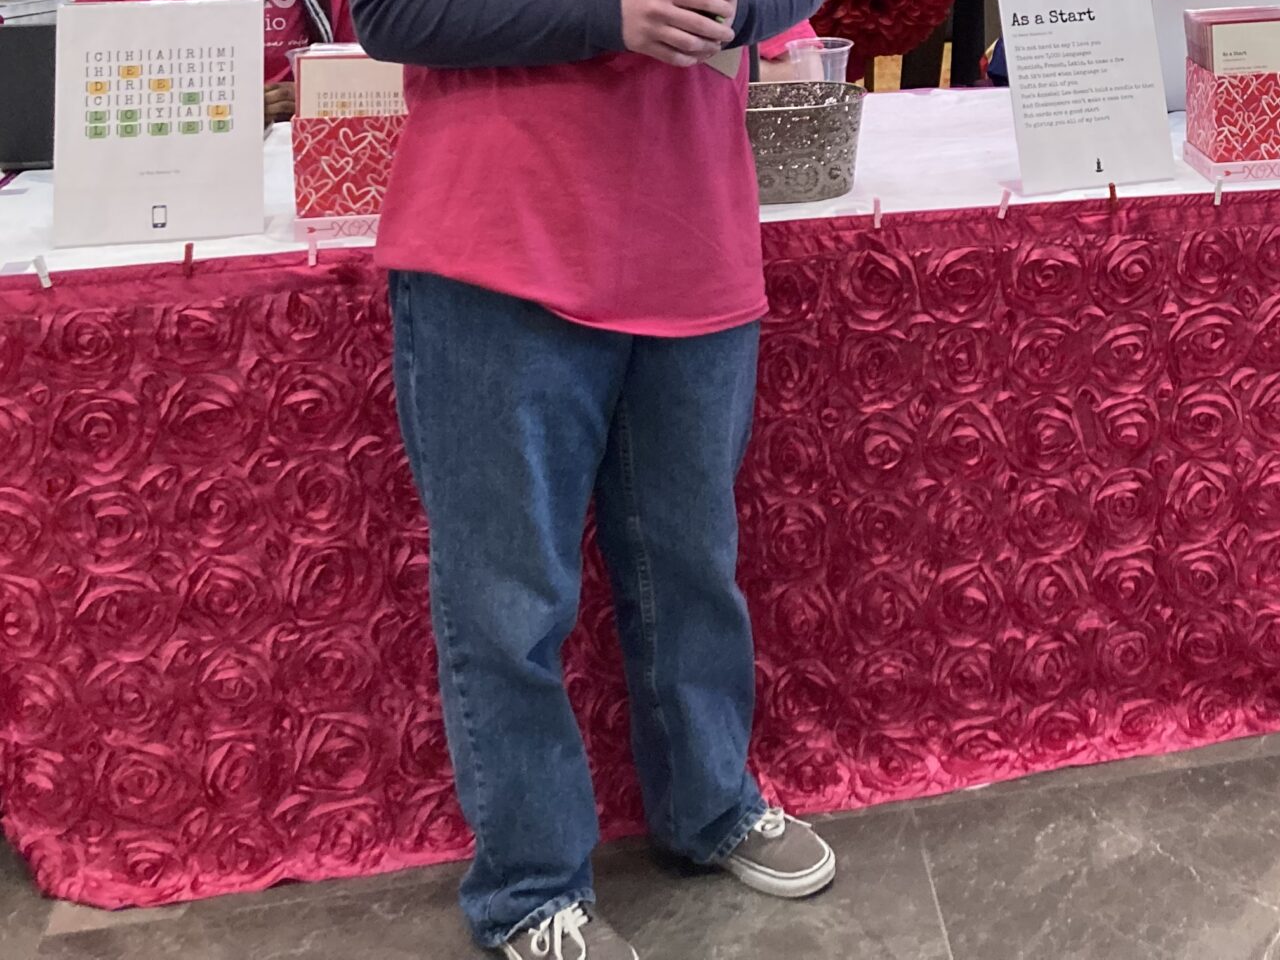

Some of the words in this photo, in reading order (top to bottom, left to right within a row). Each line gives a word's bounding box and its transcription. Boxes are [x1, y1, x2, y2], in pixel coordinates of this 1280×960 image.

[1011, 12, 1030, 27] As
[1034, 16, 1045, 25] a
[1049, 7, 1096, 24] Start
